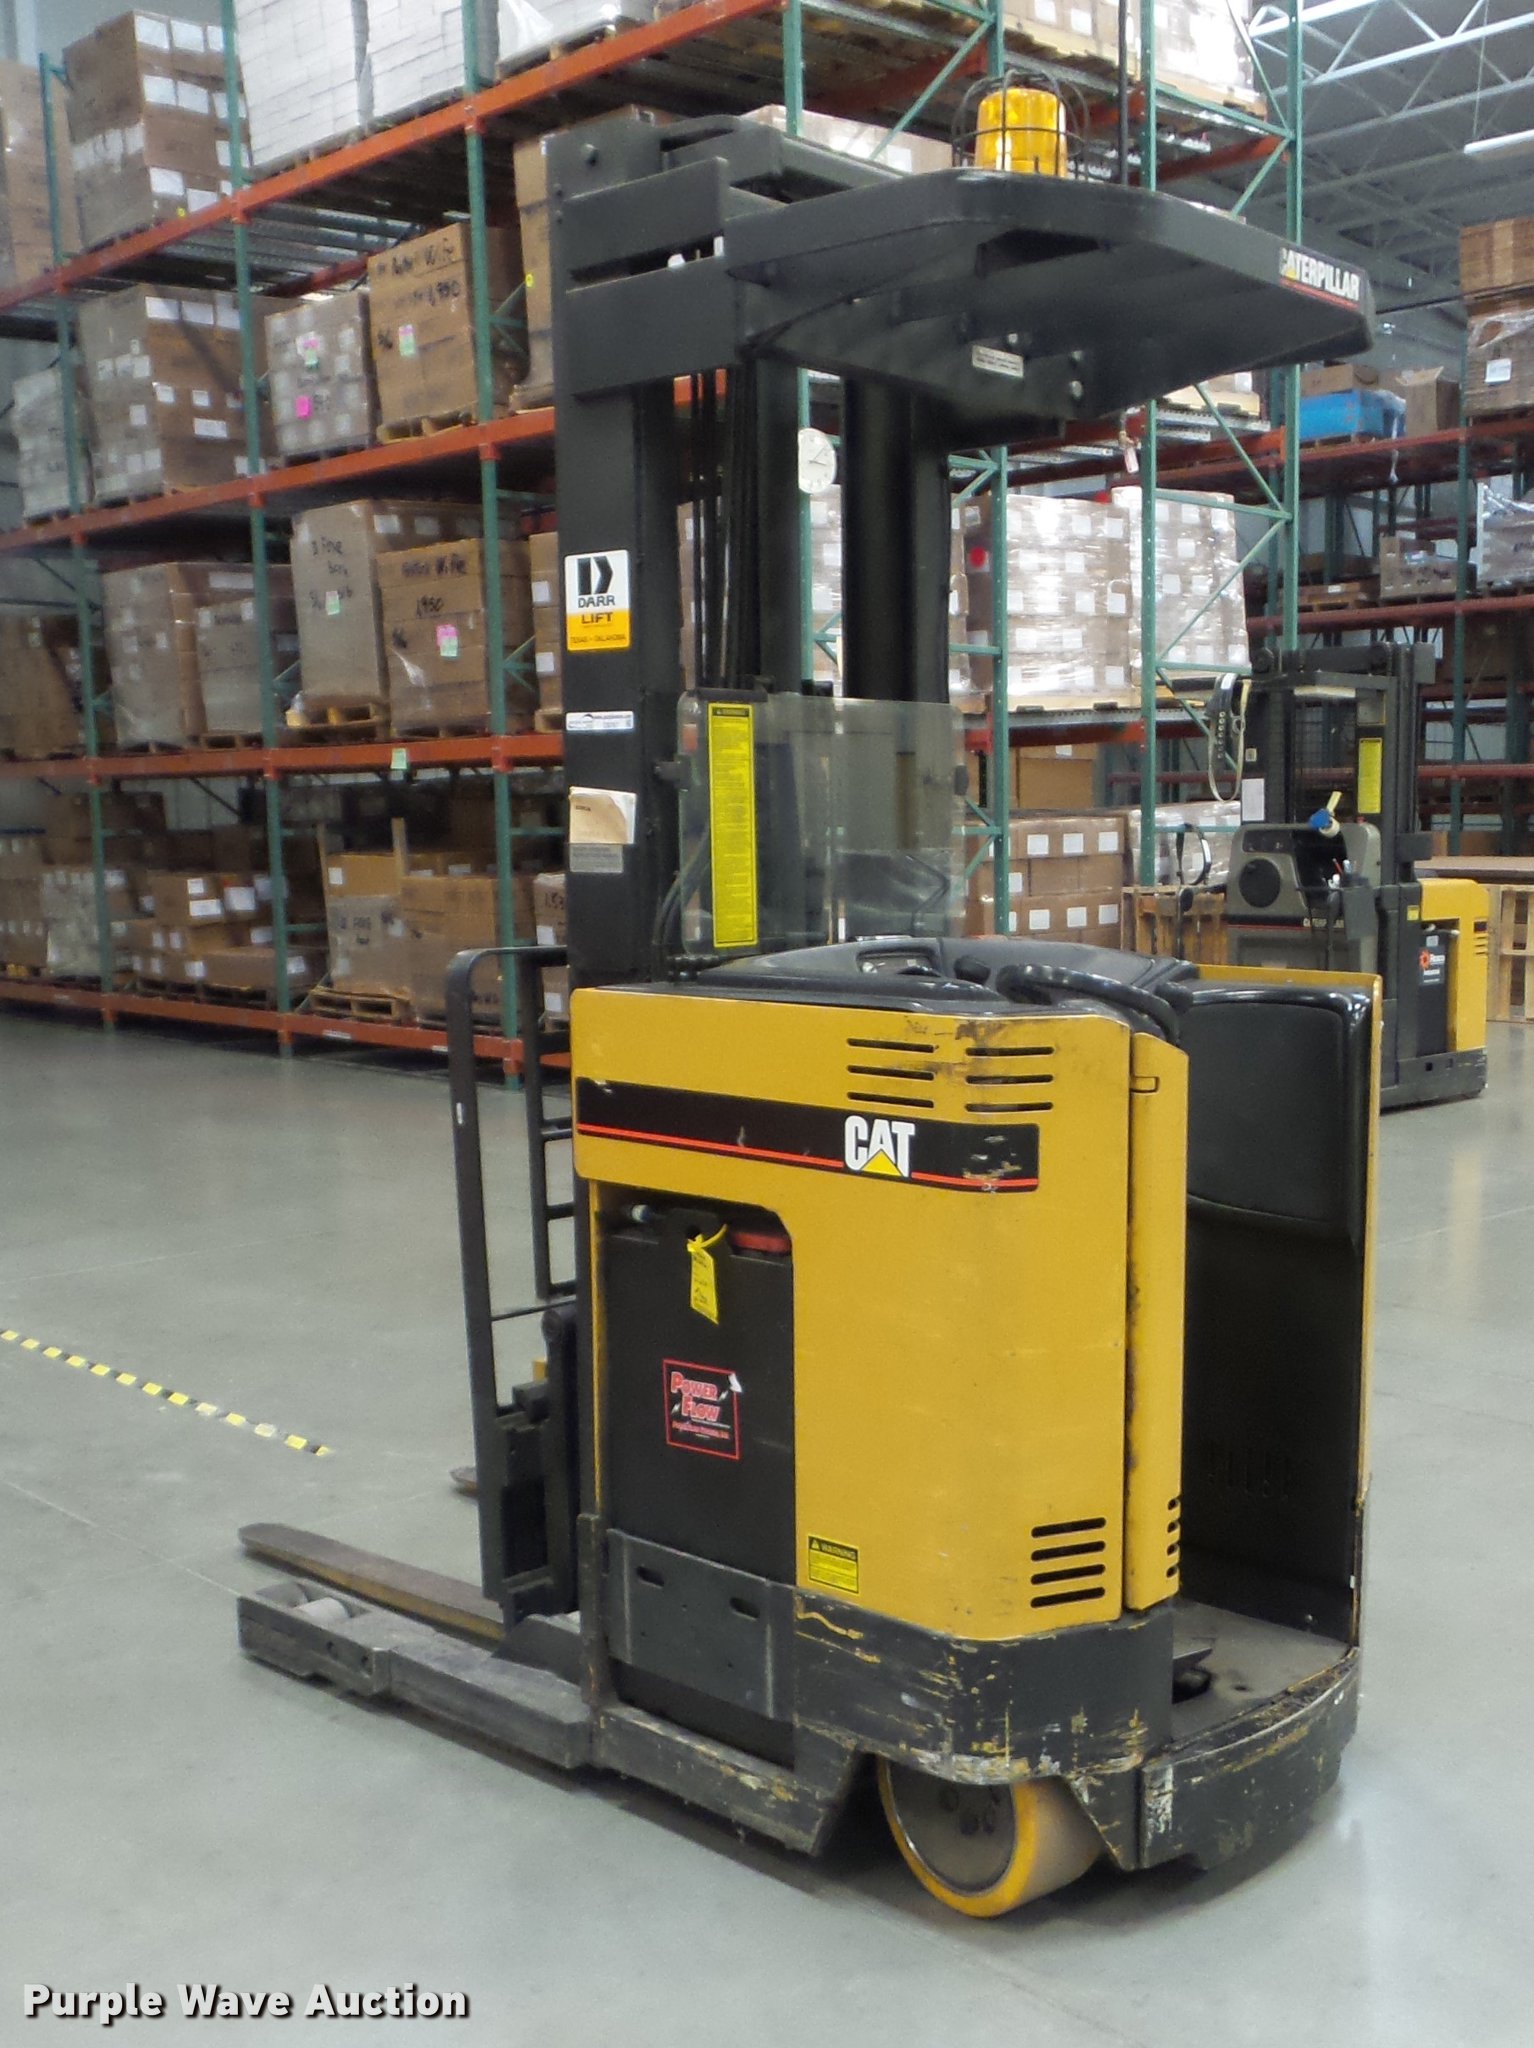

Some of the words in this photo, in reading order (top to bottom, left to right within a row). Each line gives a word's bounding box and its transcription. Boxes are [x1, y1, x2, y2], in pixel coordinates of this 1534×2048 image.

[578, 595, 615, 608] DARR
[581, 612, 613, 624] LIFT
[844, 1115, 916, 1178] CAT
[671, 1371, 718, 1401] POWER
[682, 1393, 721, 1422] FLOW
